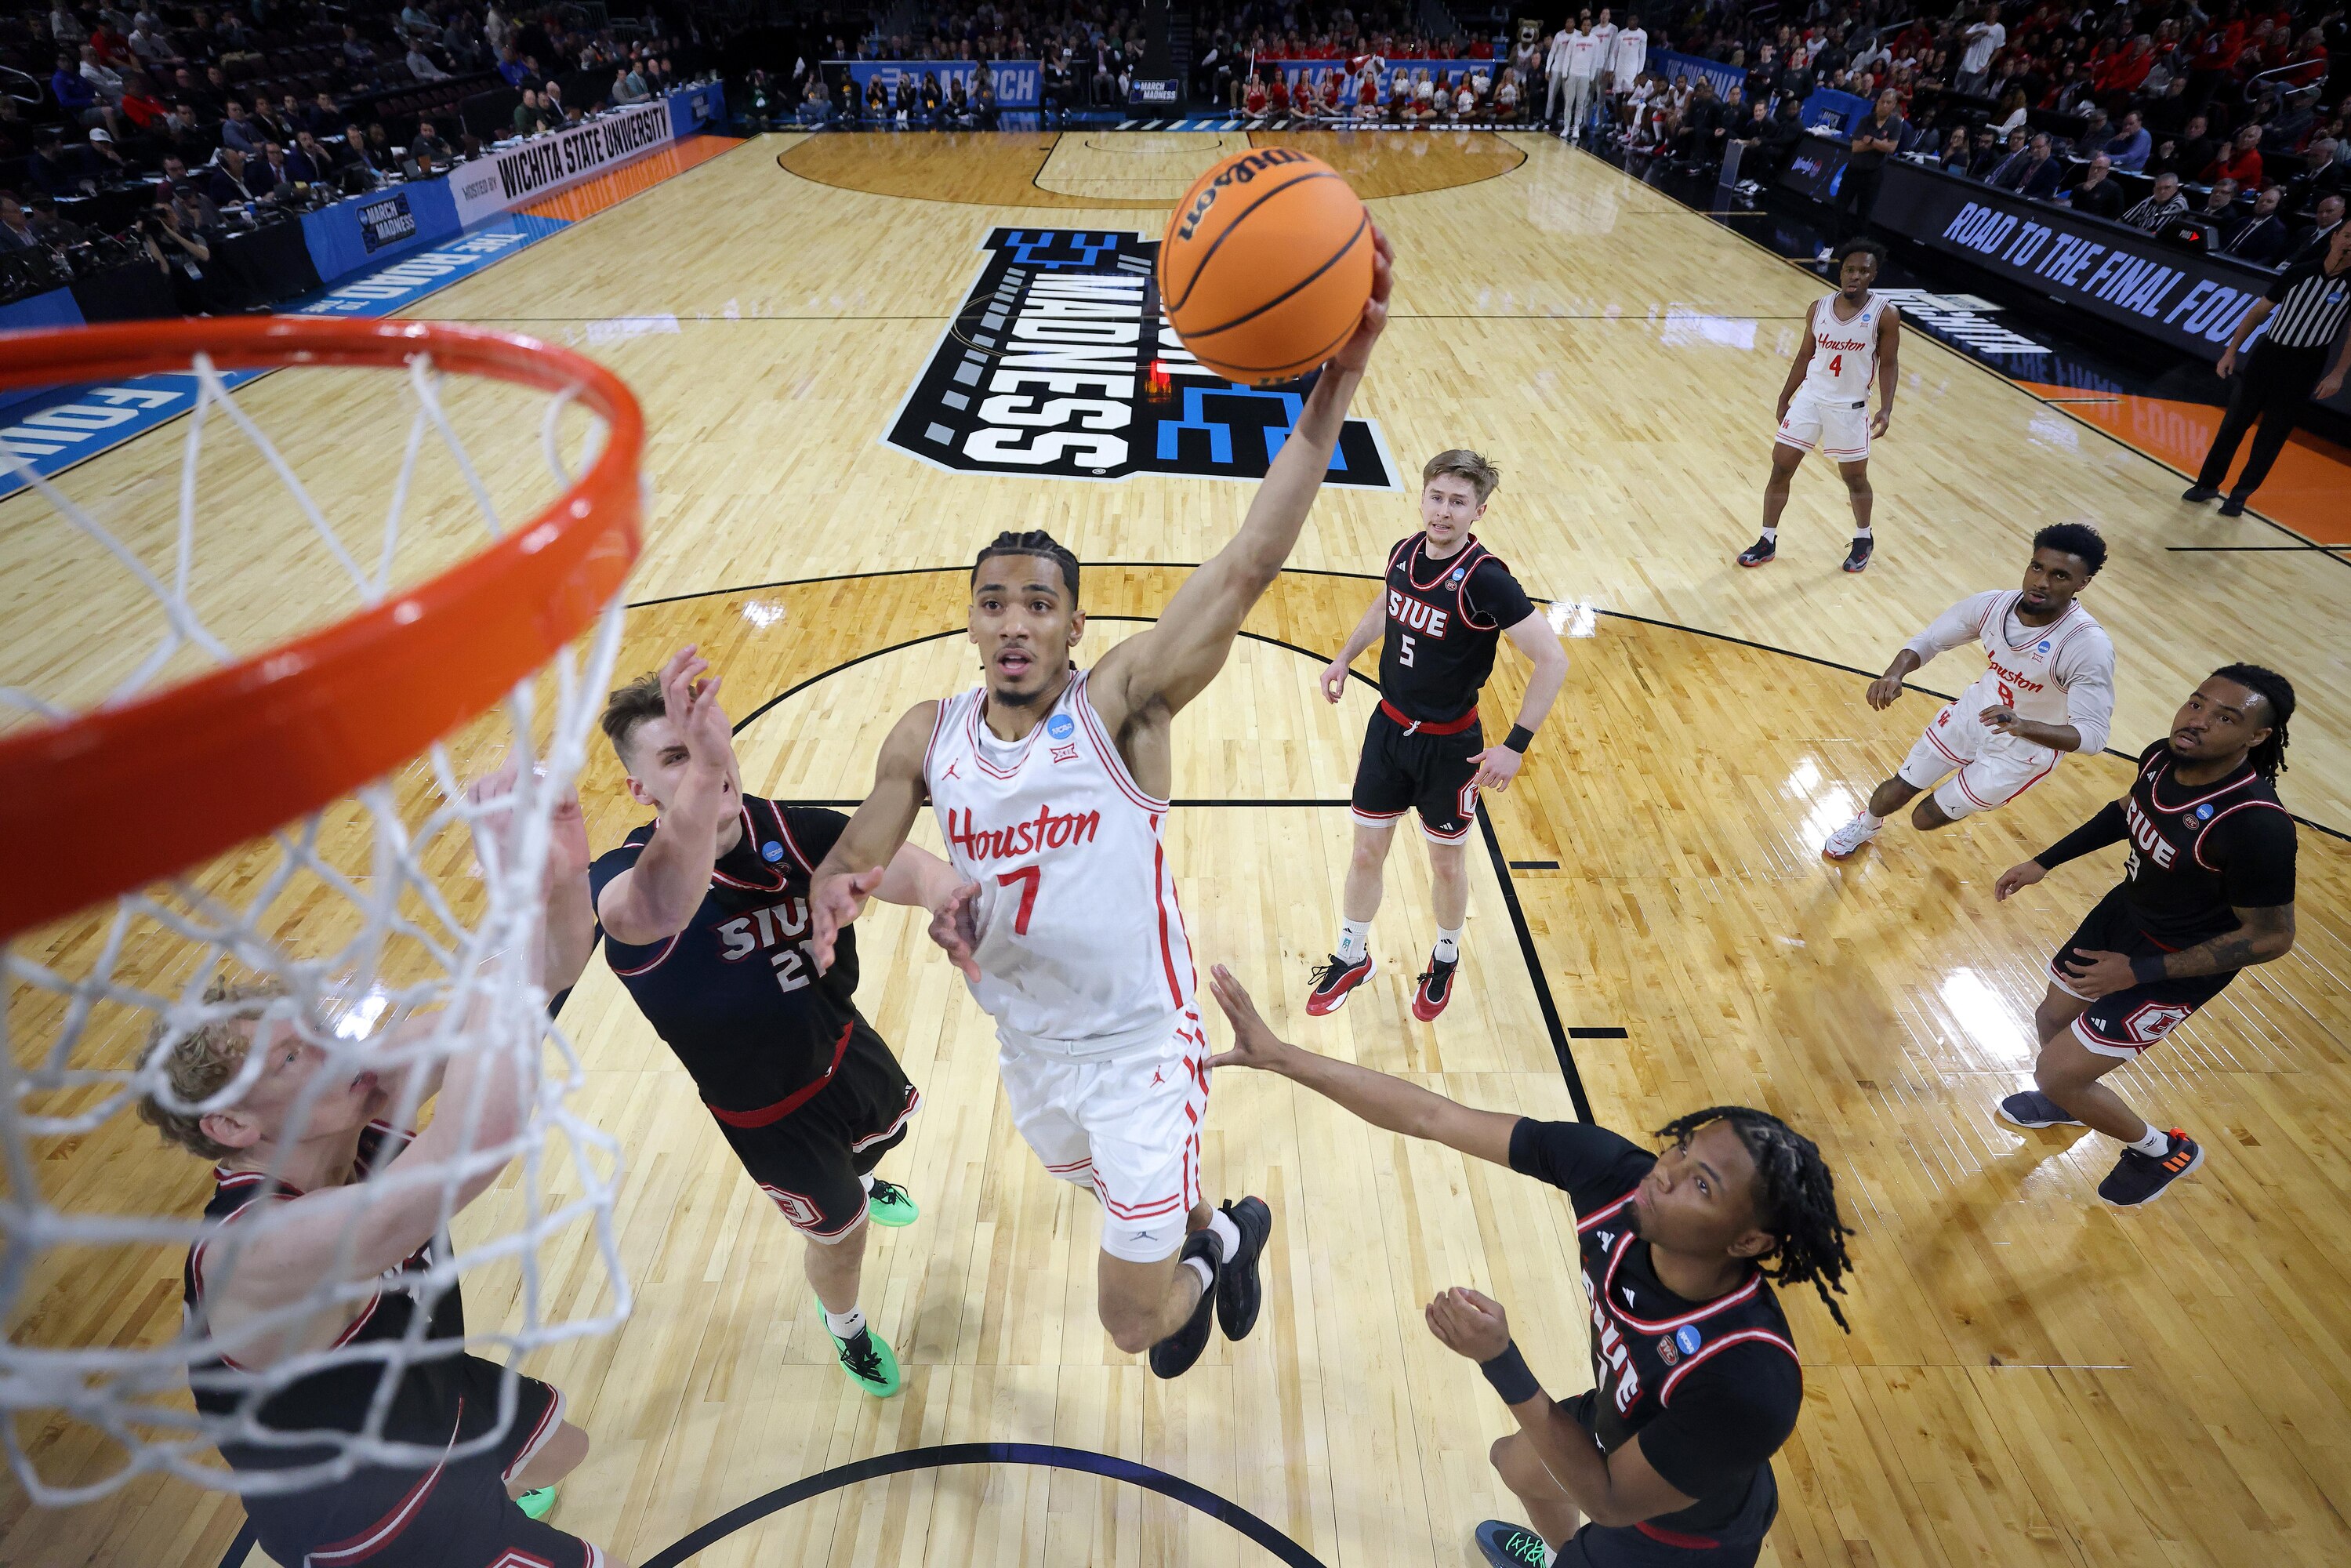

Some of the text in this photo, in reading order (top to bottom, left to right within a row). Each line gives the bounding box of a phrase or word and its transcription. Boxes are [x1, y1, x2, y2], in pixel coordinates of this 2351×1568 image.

[1141, 82, 1165, 91] MARCH
[1143, 91, 1177, 100] MADNESS
[463, 180, 488, 201] HOSTED
[488, 176, 498, 191] BY
[496, 140, 564, 199] WICHITA
[564, 127, 604, 173] STATE
[602, 105, 668, 159] UNIVERSITY
[1177, 148, 1309, 241] Wilson
[365, 201, 398, 226] MARCH
[376, 212, 415, 239] MADNESS
[453, 232, 528, 253] THE
[327, 252, 482, 299] ROAD
[1942, 201, 2283, 354] ROAD TO THE FINAL FOUR
[1818, 332, 1866, 352] Houston
[961, 272, 1145, 470] MADNESS
[1829, 354, 1842, 377] 4
[0, 387, 186, 477] FOU
[1388, 589, 1449, 639] SIUE
[1399, 633, 1417, 668] 5
[1051, 721, 1073, 735] NCAA
[2186, 817, 2197, 827] OVC
[2198, 808, 2210, 819] NCAA
[949, 804, 1101, 861] Houston
[2125, 797, 2176, 869] SIUE
[996, 865, 1041, 936] 7
[717, 897, 810, 961] SIU
[1679, 1331, 1695, 1354] NCAA
